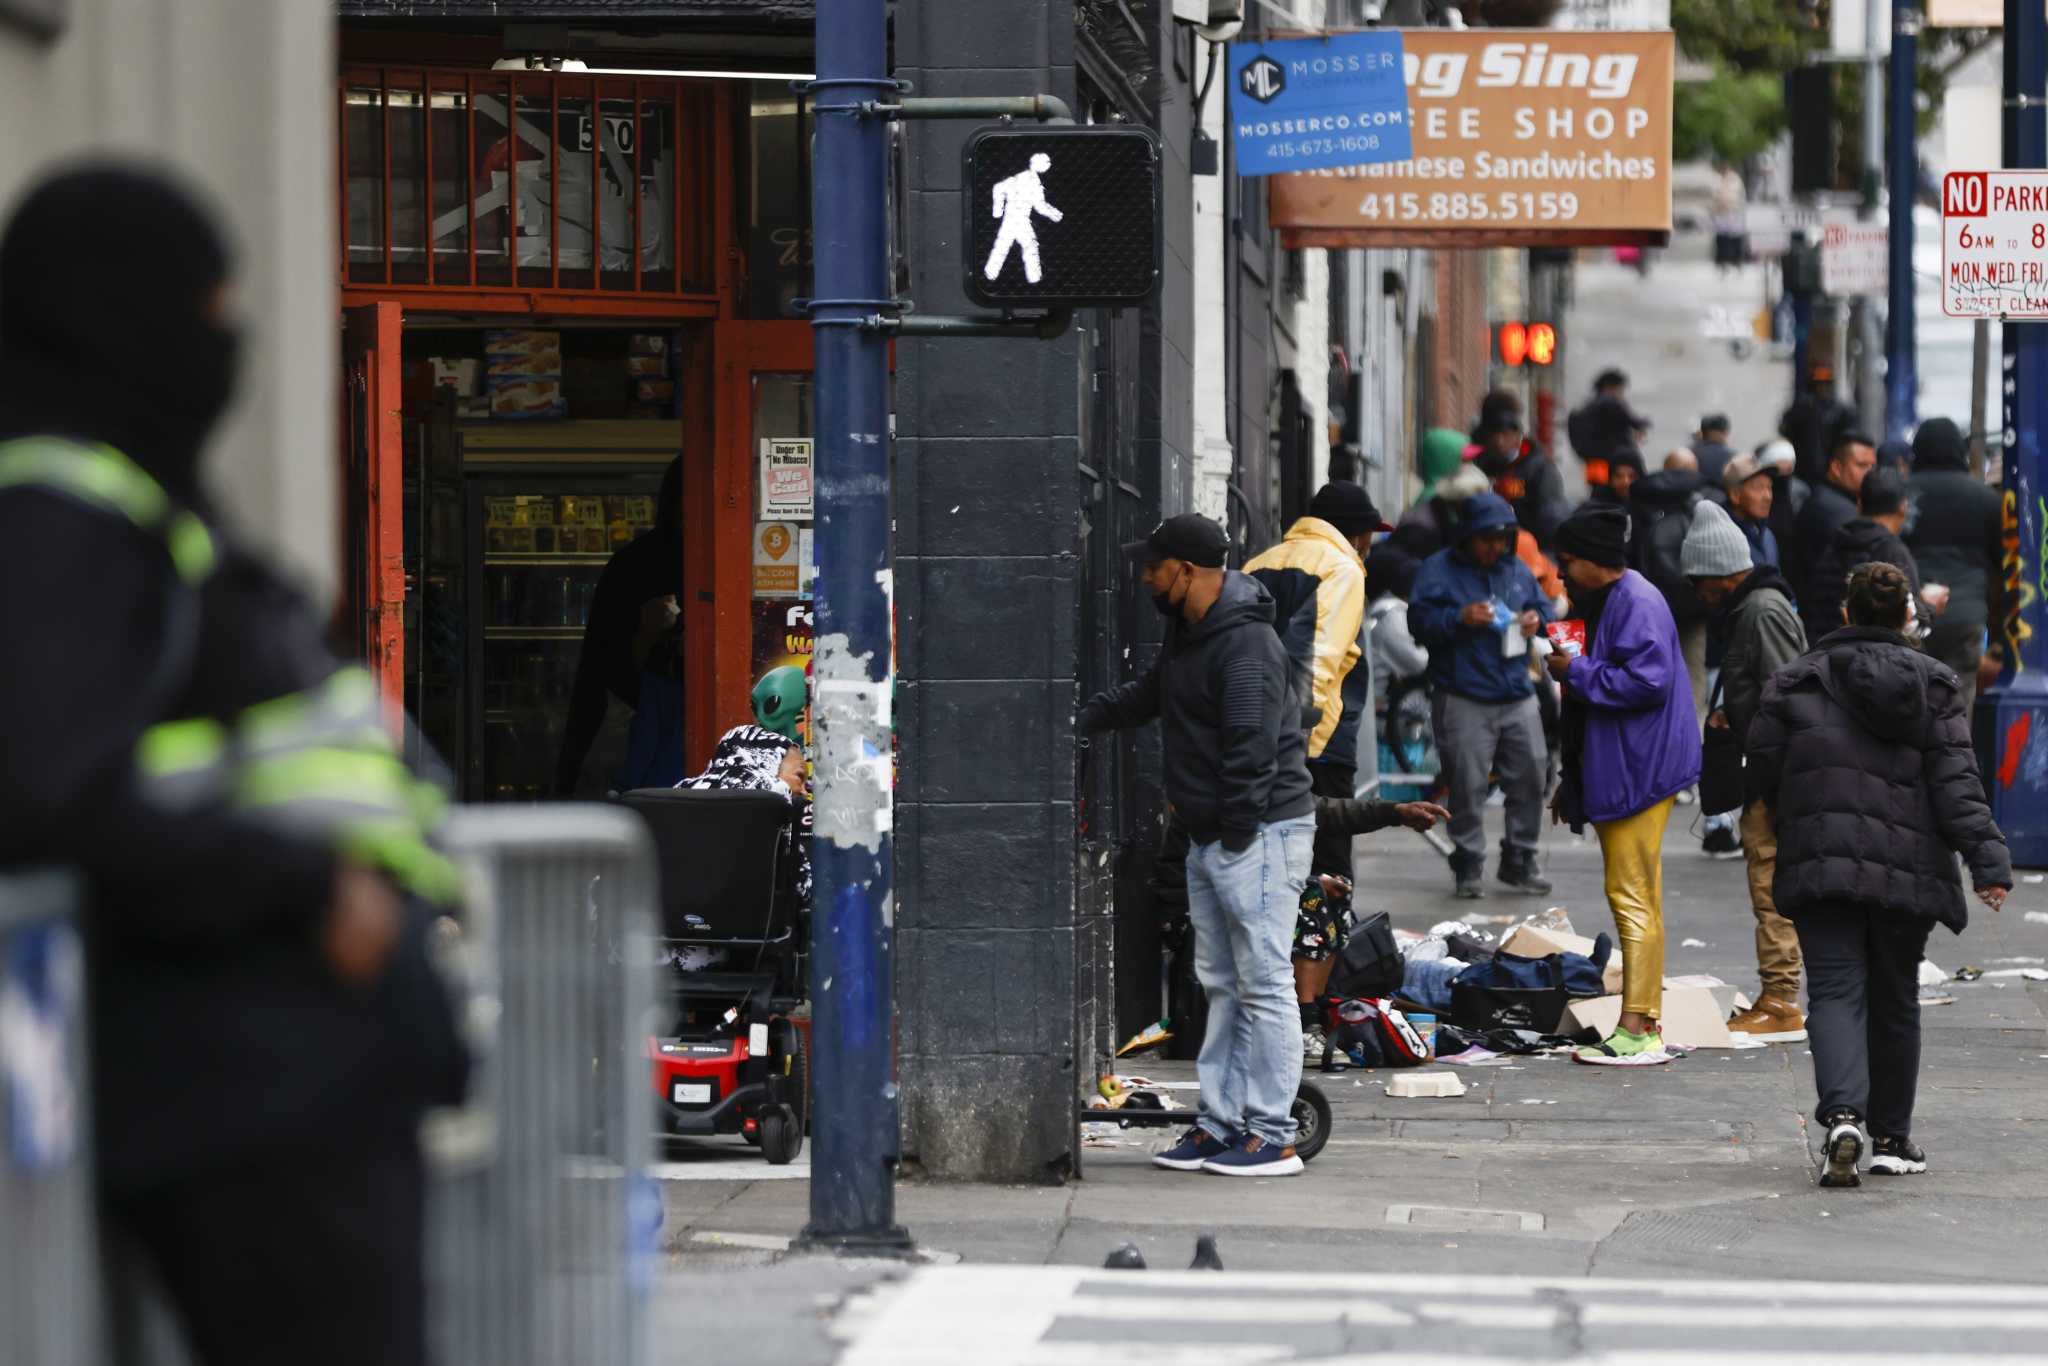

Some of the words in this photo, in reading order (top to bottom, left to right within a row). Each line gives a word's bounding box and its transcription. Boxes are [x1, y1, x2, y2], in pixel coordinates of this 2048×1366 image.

[1292, 52, 1395, 76] MOSSER
[1476, 42, 1639, 98] Sing
[1240, 111, 1402, 138] MOSSERCO.COM
[1514, 108, 1649, 139] SHOP
[1267, 135, 1380, 157] 415-673-1608
[1474, 150, 1656, 179] Sandwiches
[1360, 191, 1579, 220] 415.885.5159
[1948, 176, 1982, 213] NO
[2008, 240, 2018, 249] TO
[2032, 223, 2045, 249] 8
[1951, 262, 1980, 283] MON
[1987, 262, 2015, 283] WED
[2022, 262, 2043, 283] FRI
